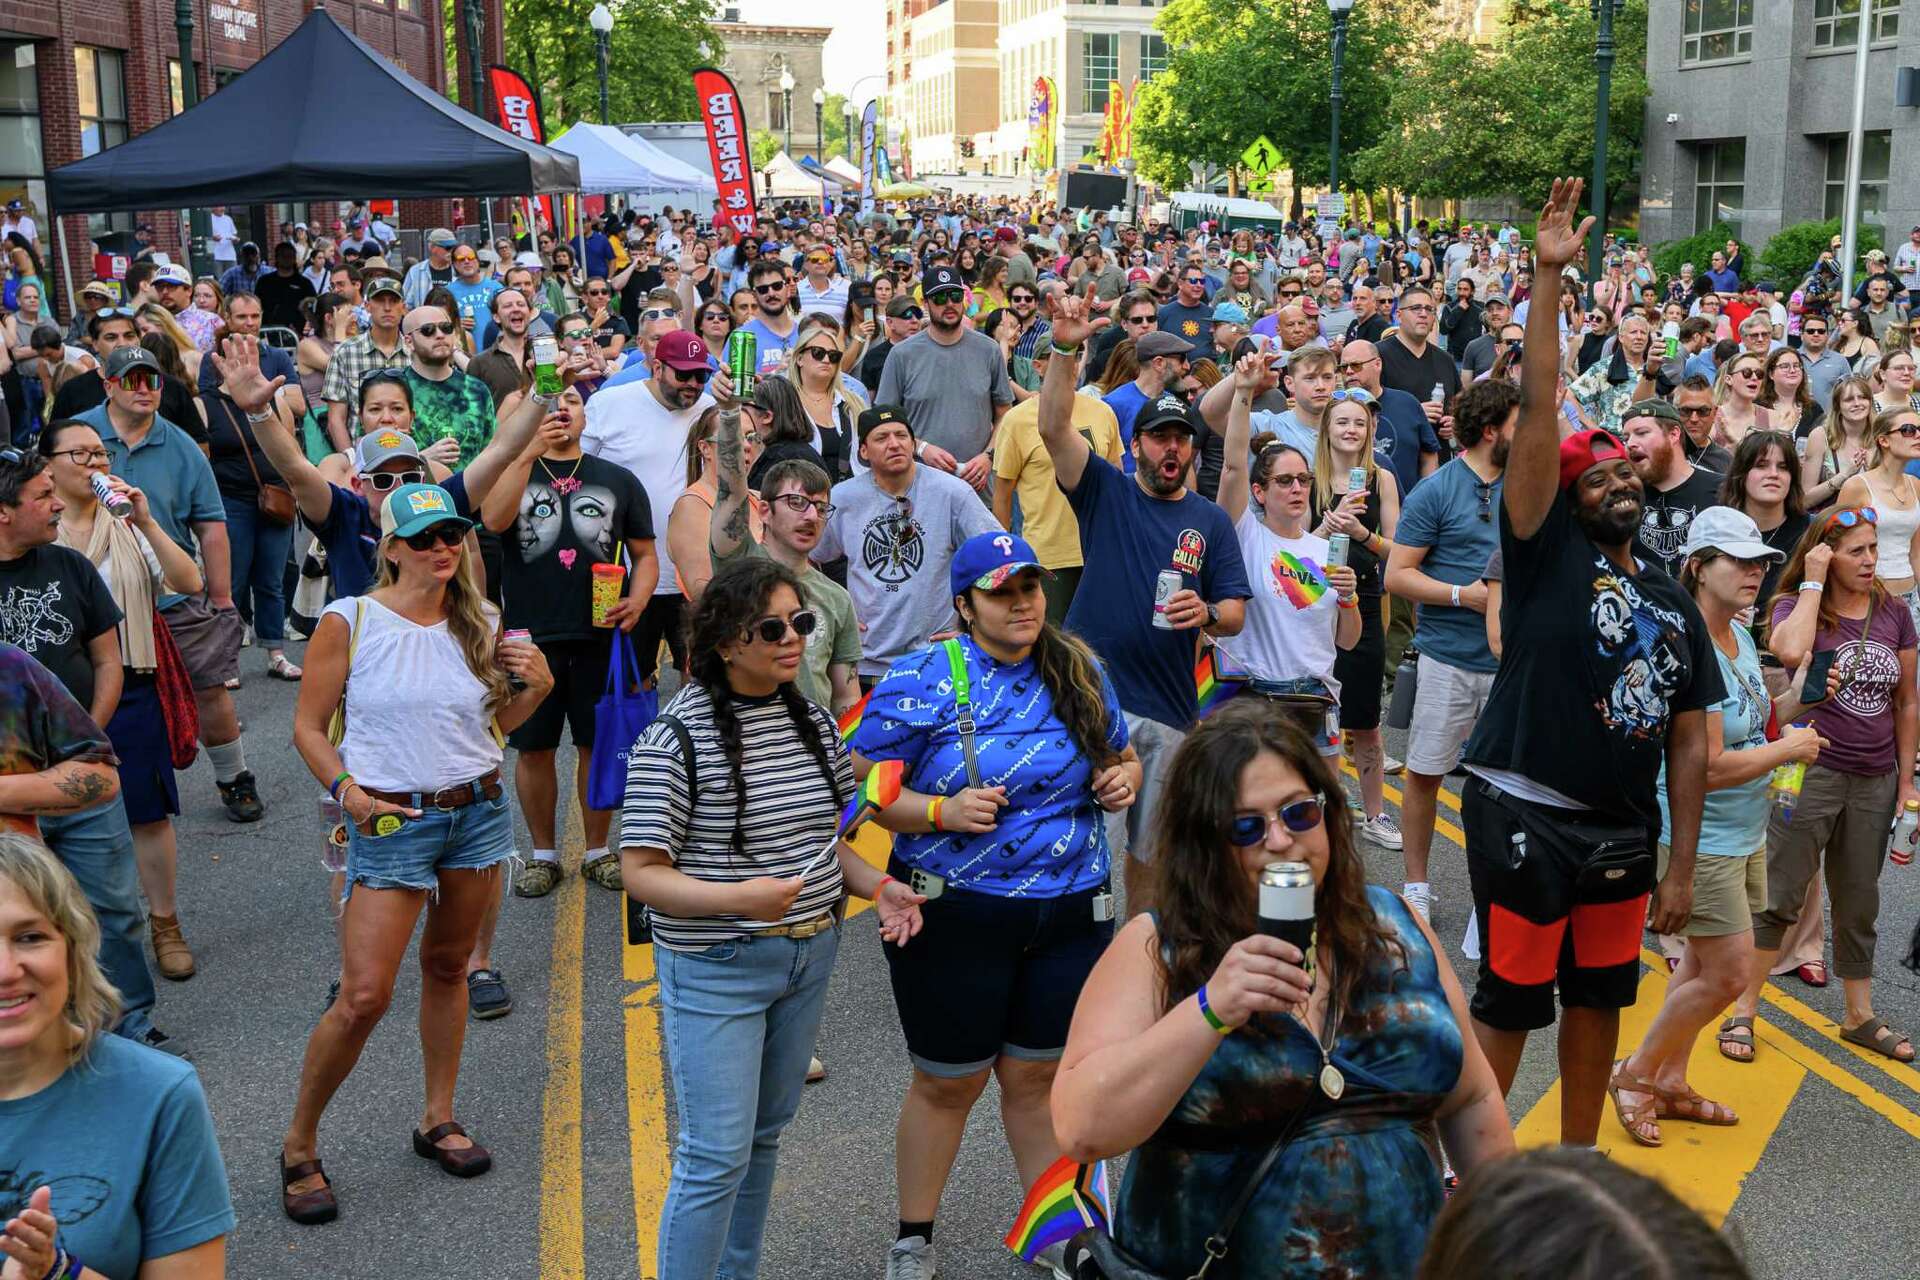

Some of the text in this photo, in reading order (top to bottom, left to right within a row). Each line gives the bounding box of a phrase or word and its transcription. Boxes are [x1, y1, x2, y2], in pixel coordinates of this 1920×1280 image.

[210, 3, 258, 28] ALBANY UPSTATE
[224, 22, 247, 41] DENTAL
[993, 535, 1013, 556] P
[1279, 565, 1319, 586] LOVE
[885, 584, 899, 592] 518
[983, 738, 1047, 786] Champion
